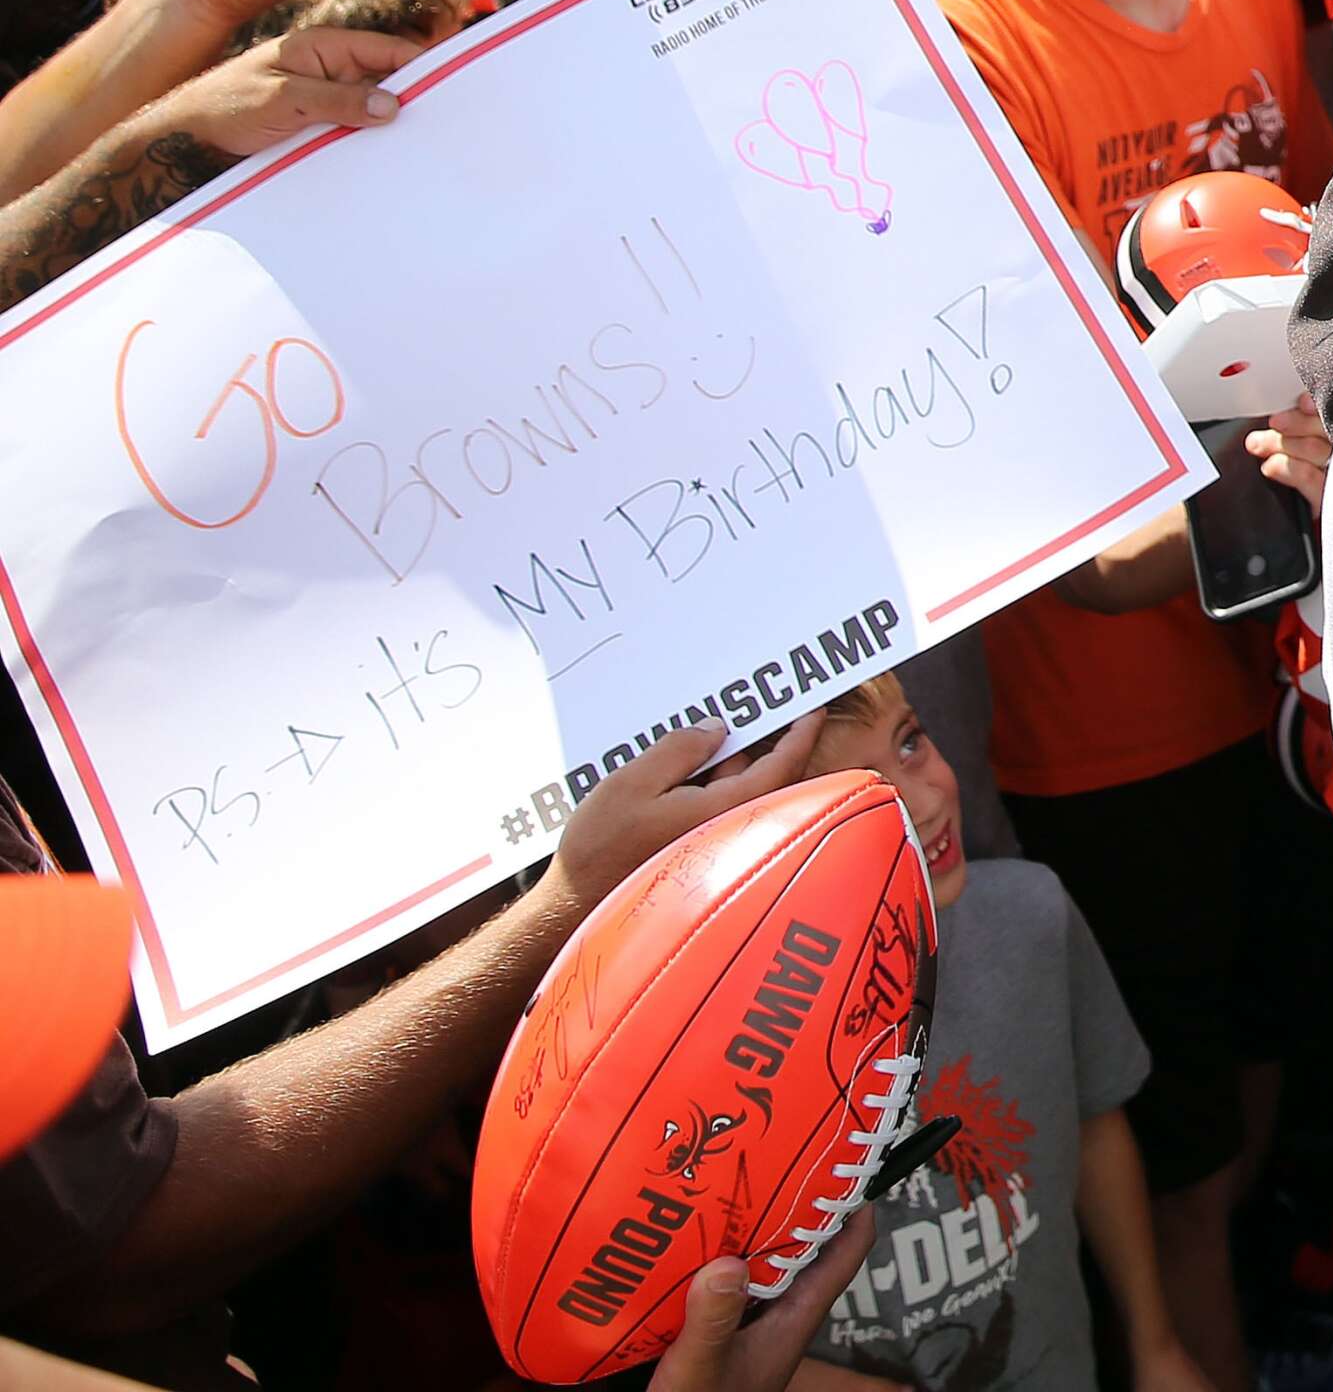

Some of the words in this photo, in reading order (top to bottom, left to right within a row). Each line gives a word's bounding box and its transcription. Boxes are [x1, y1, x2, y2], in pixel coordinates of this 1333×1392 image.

[650, 30, 691, 59] RADIO
[690, 13, 726, 41] HOME
[725, 0, 742, 20] OF
[115, 319, 346, 529] Go
[603, 285, 1013, 584] Birthday!
[724, 918, 842, 1079] DAWG
[557, 1186, 694, 1327] POUND
